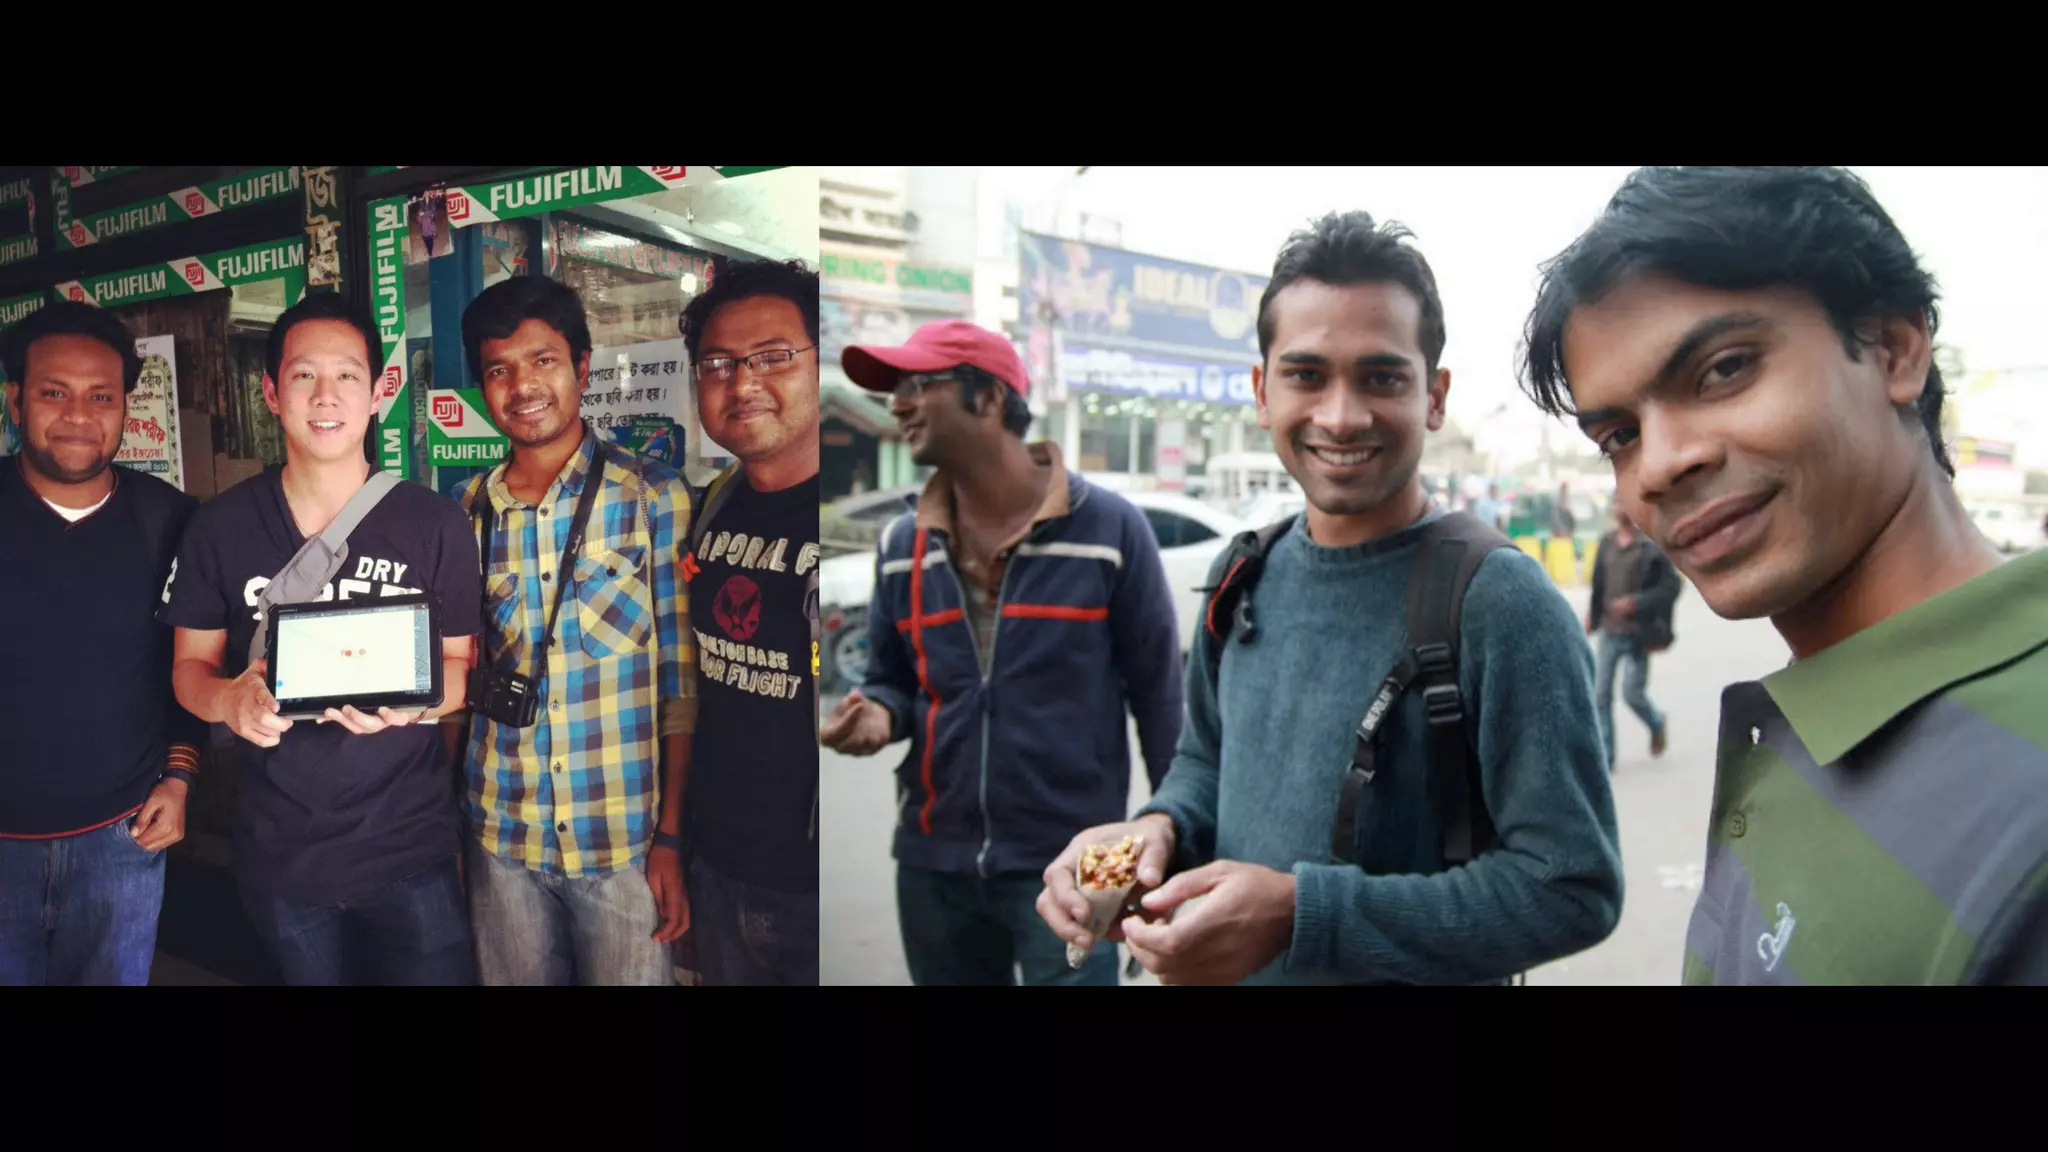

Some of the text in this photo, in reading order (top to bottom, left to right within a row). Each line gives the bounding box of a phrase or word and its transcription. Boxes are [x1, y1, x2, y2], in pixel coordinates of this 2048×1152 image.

[490, 166, 622, 213] FUJIFILM
[95, 202, 167, 238] FUJIFILM
[217, 243, 304, 280] FUJIFILM
[375, 204, 399, 343] FUJIFILM
[94, 270, 167, 302] FUJIFILM
[433, 396, 463, 428] FUJI
[432, 444, 504, 460] FUJIFILM
[355, 556, 408, 583] DRY
[726, 663, 802, 700] FLIGHT
